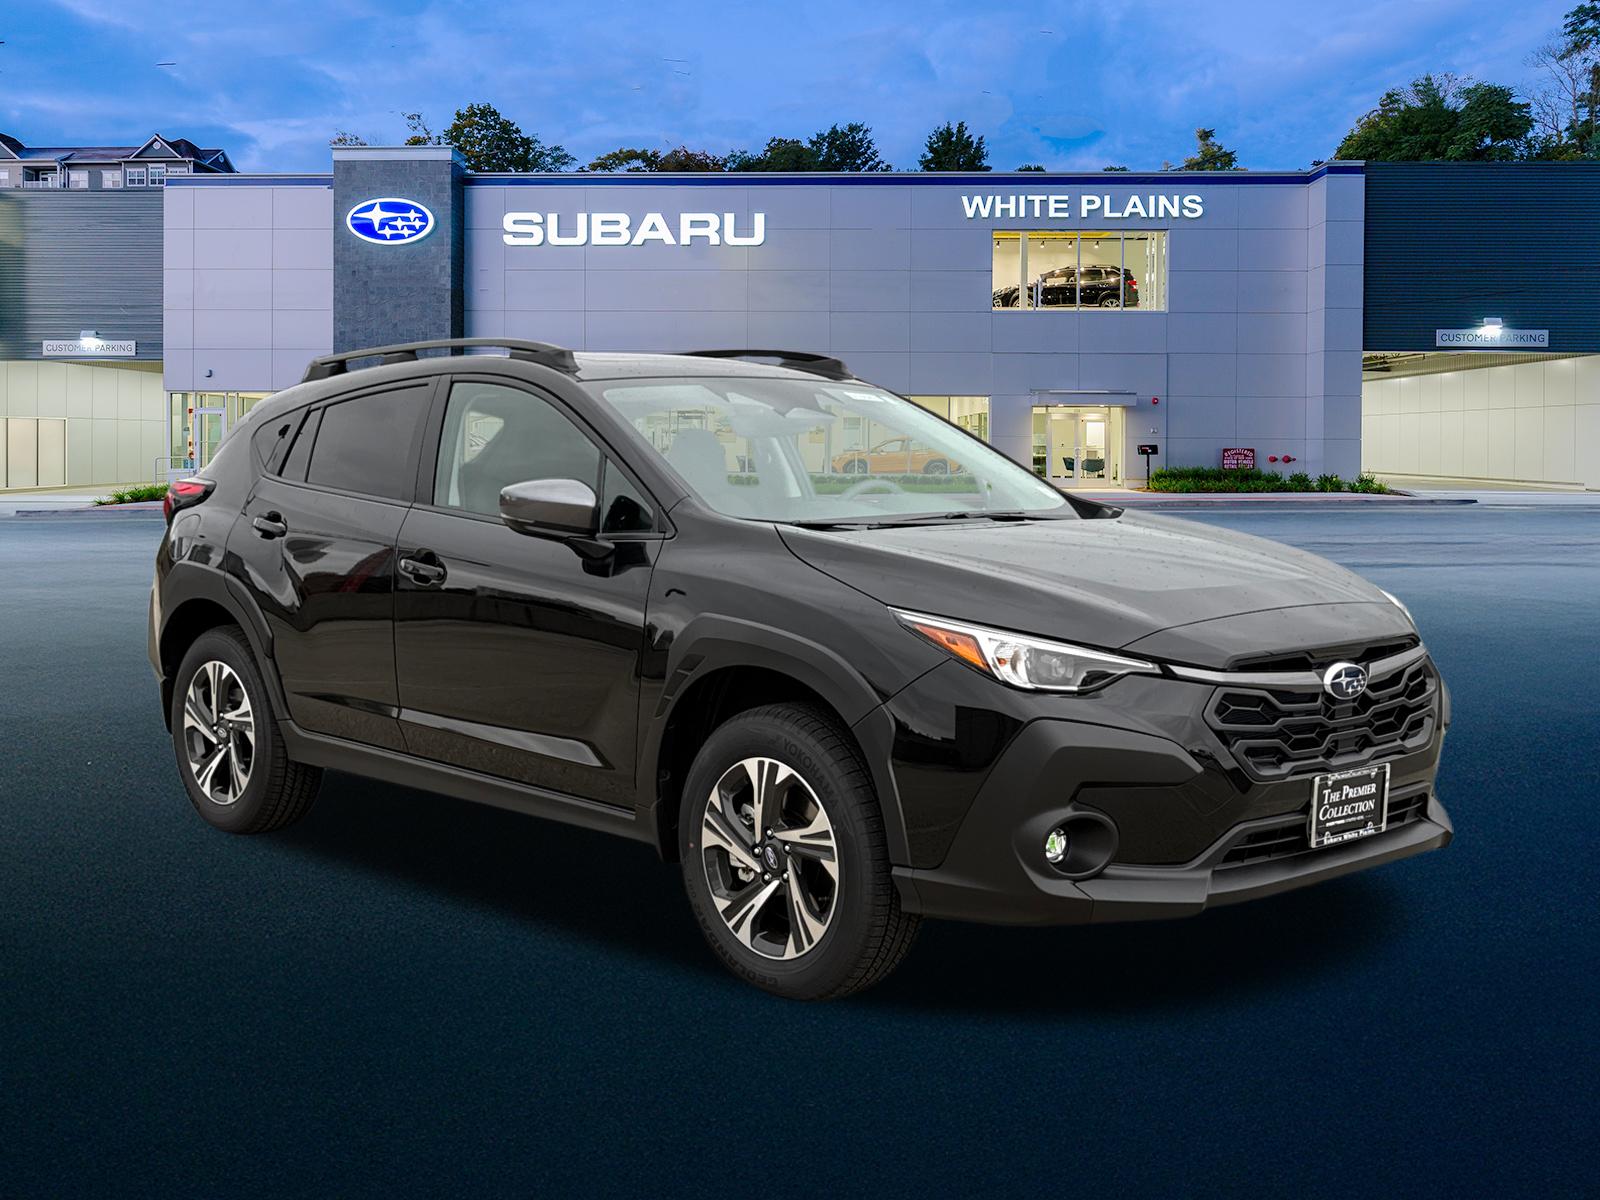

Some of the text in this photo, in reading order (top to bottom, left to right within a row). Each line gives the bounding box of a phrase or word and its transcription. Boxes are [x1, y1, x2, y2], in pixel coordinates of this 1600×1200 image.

[961, 195, 1204, 218] WHITE PLAINS
[503, 212, 766, 247] SUBARU
[95, 344, 133, 352] PARKING
[1440, 333, 1545, 343] CUSTOMER PARKING
[783, 738, 839, 808] YOKOHAMA
[1322, 783, 1377, 805] THE PREMIER
[1319, 799, 1376, 821] COLLECTION
